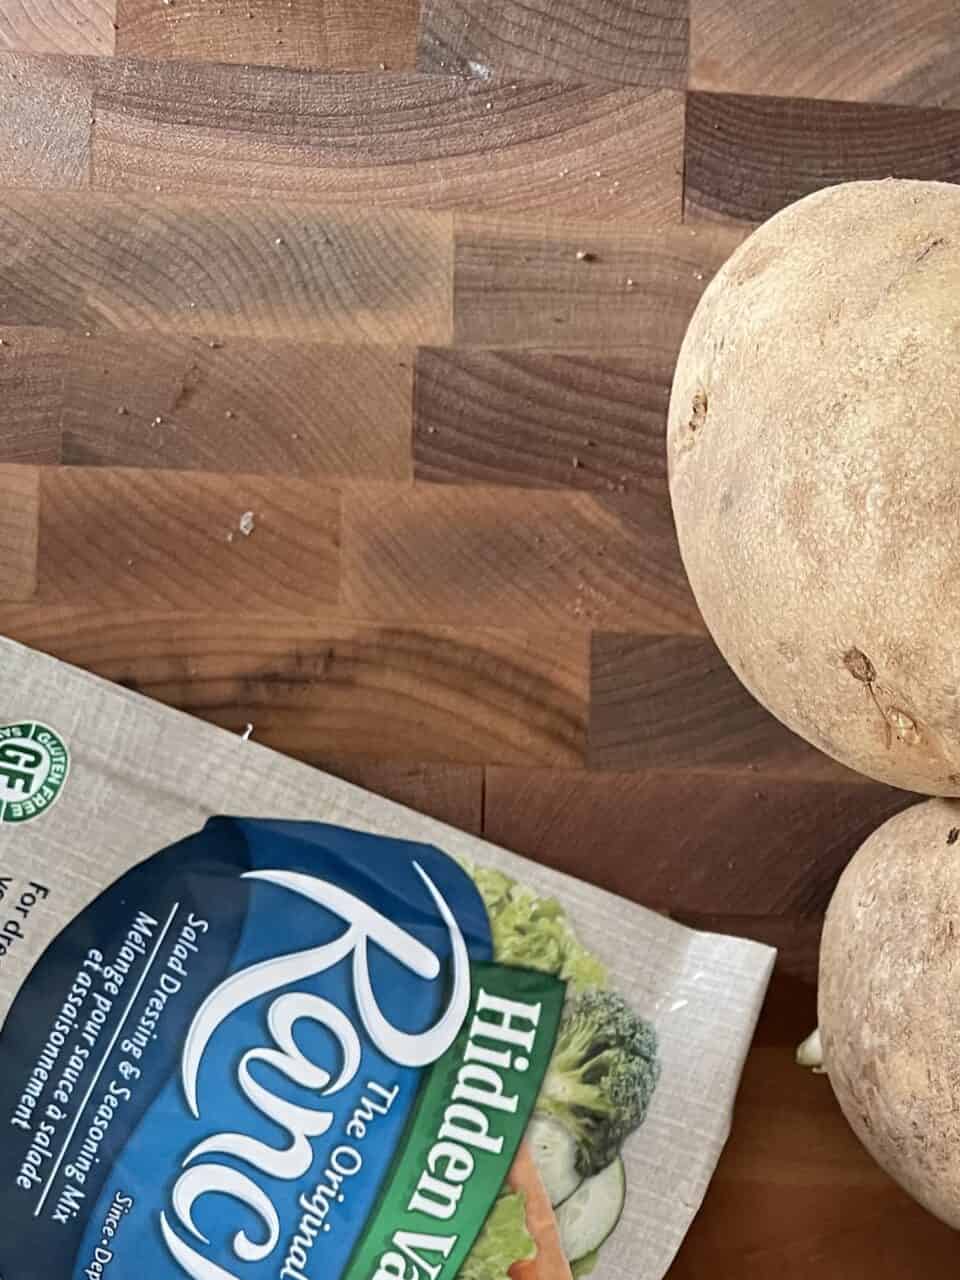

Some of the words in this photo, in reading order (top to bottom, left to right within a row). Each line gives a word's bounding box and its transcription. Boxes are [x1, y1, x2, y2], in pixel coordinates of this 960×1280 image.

[0, 743, 43, 794] GF
[37, 732, 66, 785] GLUTEN
[10, 785, 55, 817] FREE
[15, 881, 51, 919] For
[83, 948, 105, 973] et
[104, 910, 159, 996] Mélange
[167, 912, 209, 977] Salad
[81, 992, 113, 1047] pour
[120, 974, 182, 1060] Dressing
[11, 971, 92, 1131] assaisonnement
[53, 1045, 90, 1103] sauce
[118, 1060, 142, 1082] &
[47, 1103, 68, 1122] à
[346, 1079, 400, 1141] The
[407, 988, 541, 1221] Hidden
[16, 1121, 56, 1191] salade
[65, 1080, 132, 1186] Seasoning
[51, 1184, 86, 1225] Mix
[102, 1191, 133, 1237] Since
